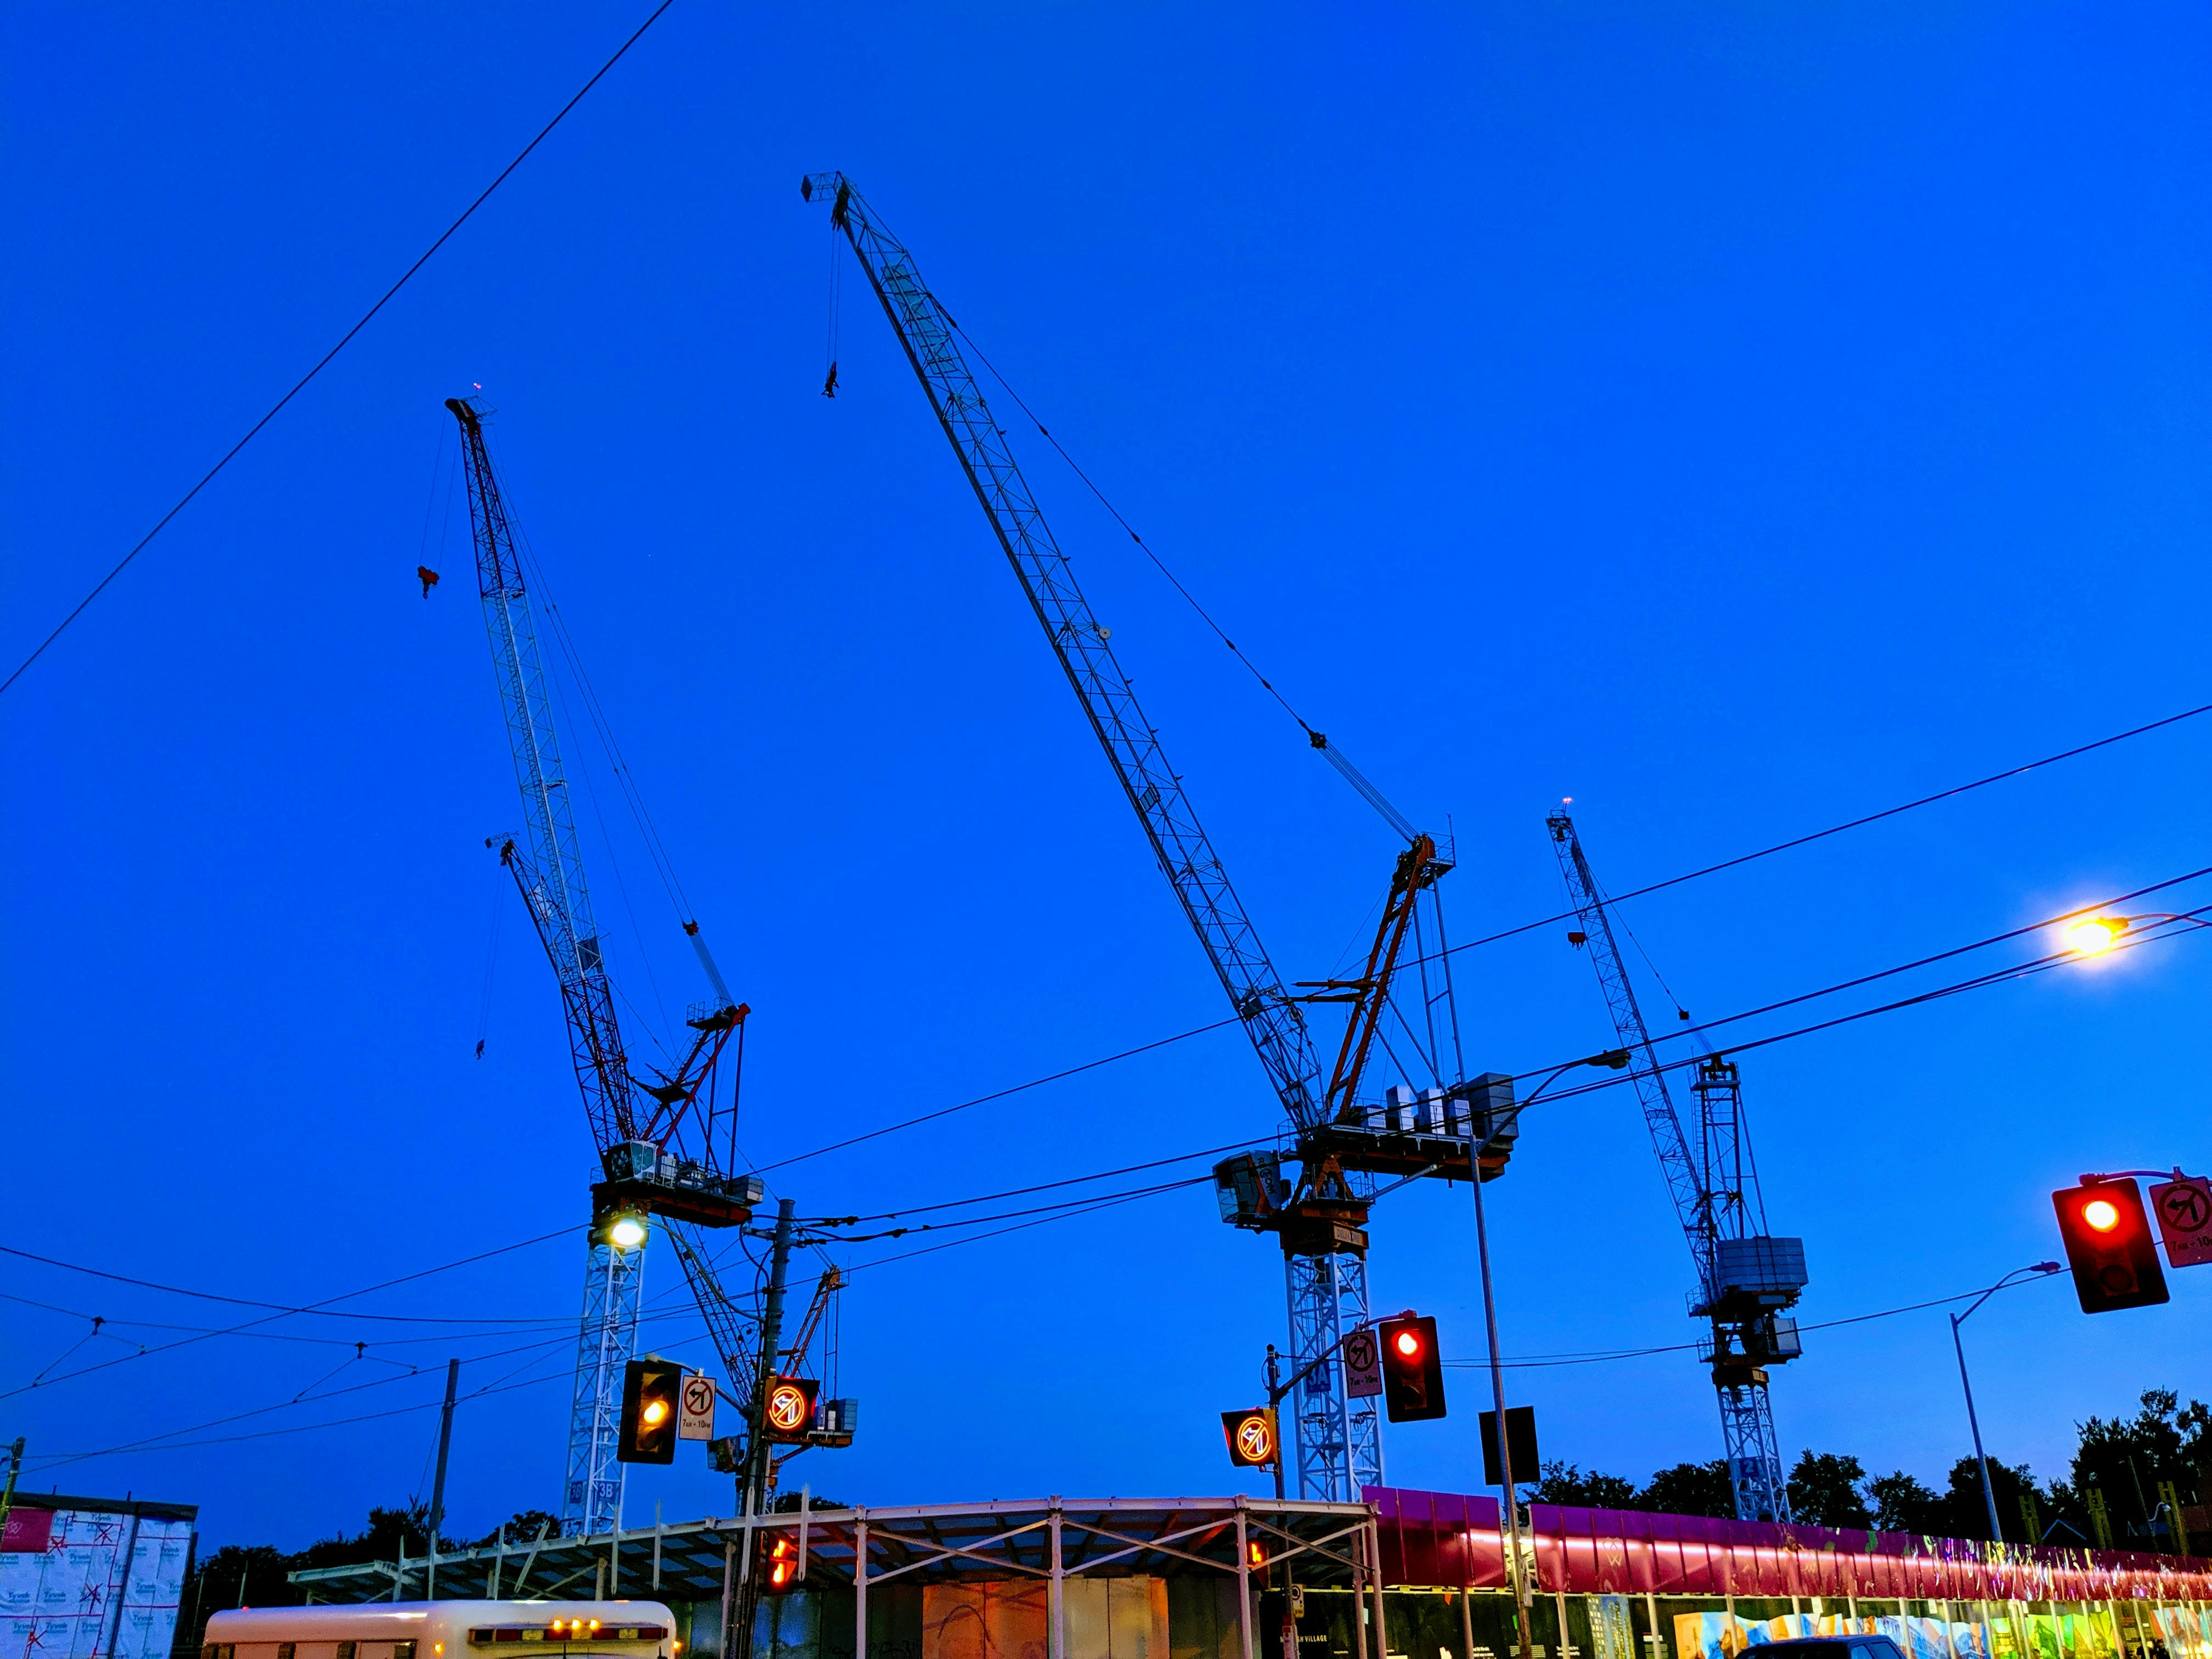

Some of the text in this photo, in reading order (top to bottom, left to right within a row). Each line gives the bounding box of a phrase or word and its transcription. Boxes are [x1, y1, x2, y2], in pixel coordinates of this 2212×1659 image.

[1308, 1363, 1329, 1386] 3A
[1743, 1460, 1754, 1472] 2
[600, 1483, 613, 1497] 3B
